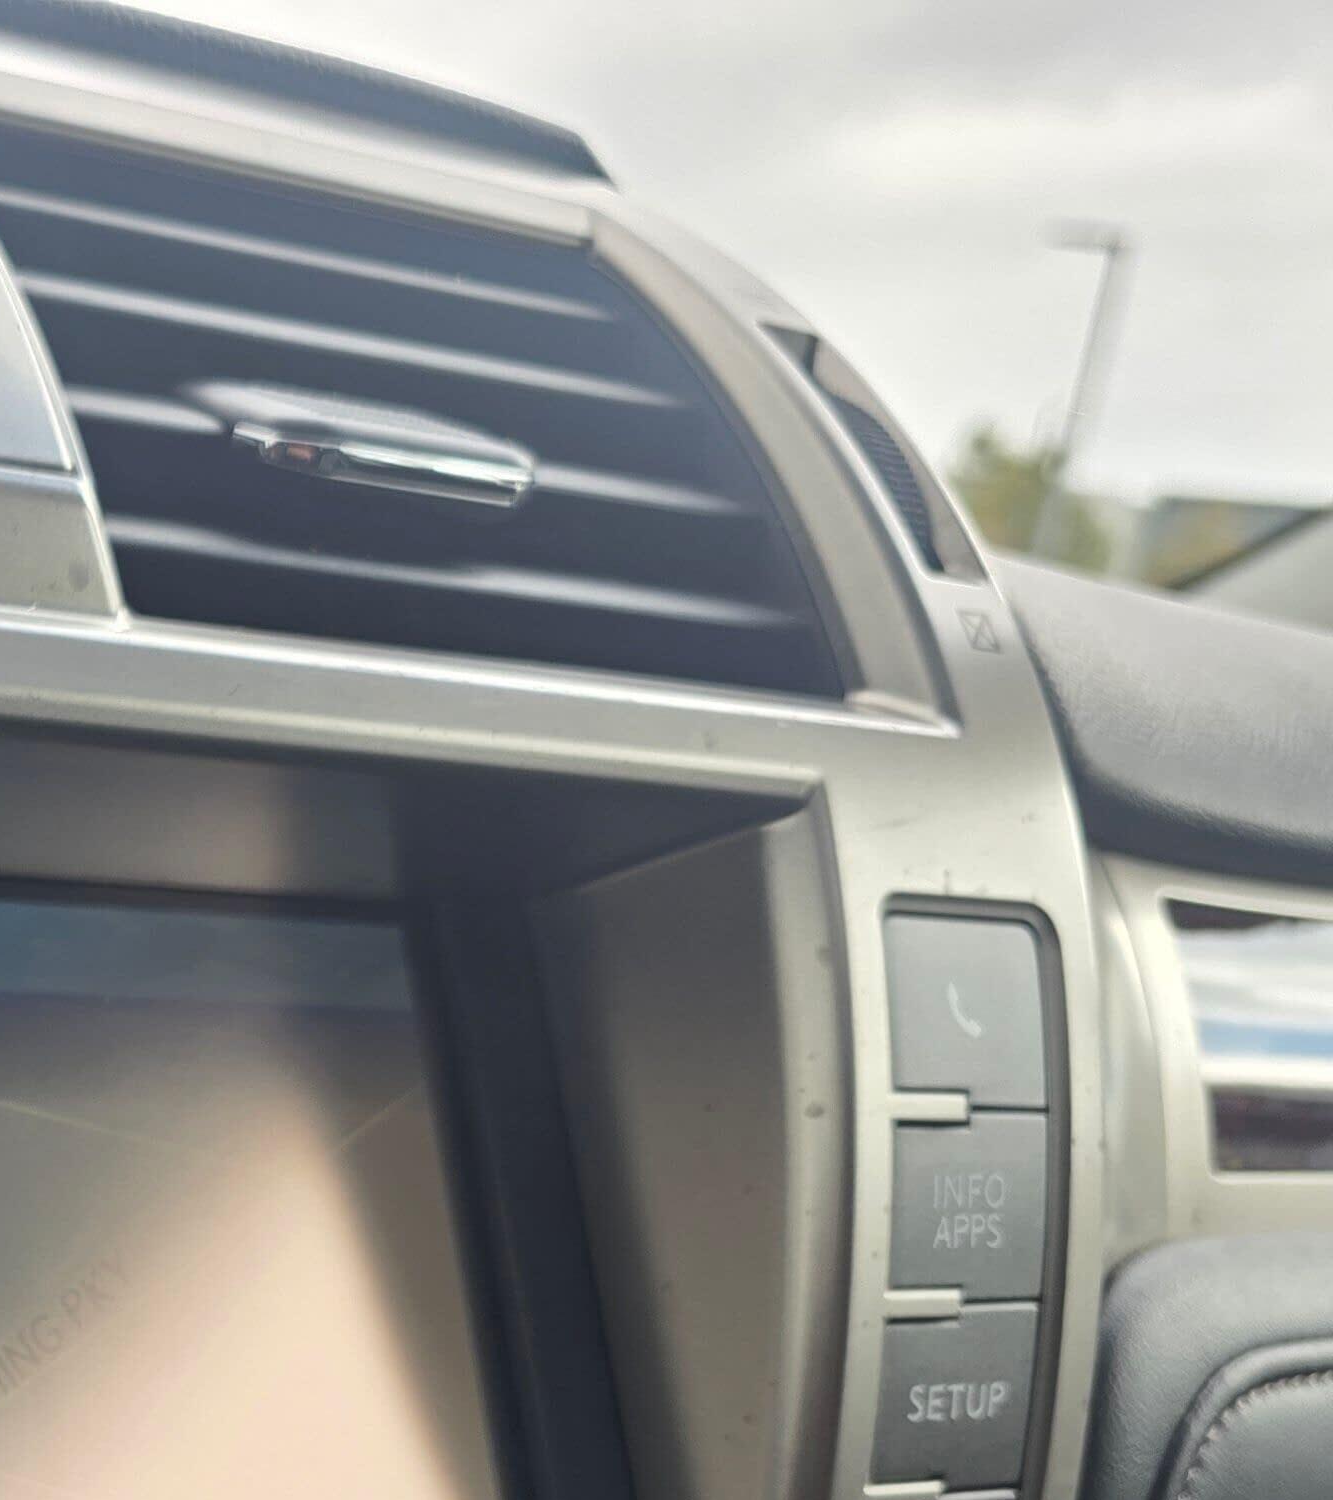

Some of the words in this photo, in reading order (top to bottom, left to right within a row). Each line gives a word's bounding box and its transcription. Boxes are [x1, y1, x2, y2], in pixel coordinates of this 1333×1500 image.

[933, 1172, 1006, 1209] INFO
[933, 1214, 1004, 1249] APPS
[907, 1380, 1007, 1423] SETUP
